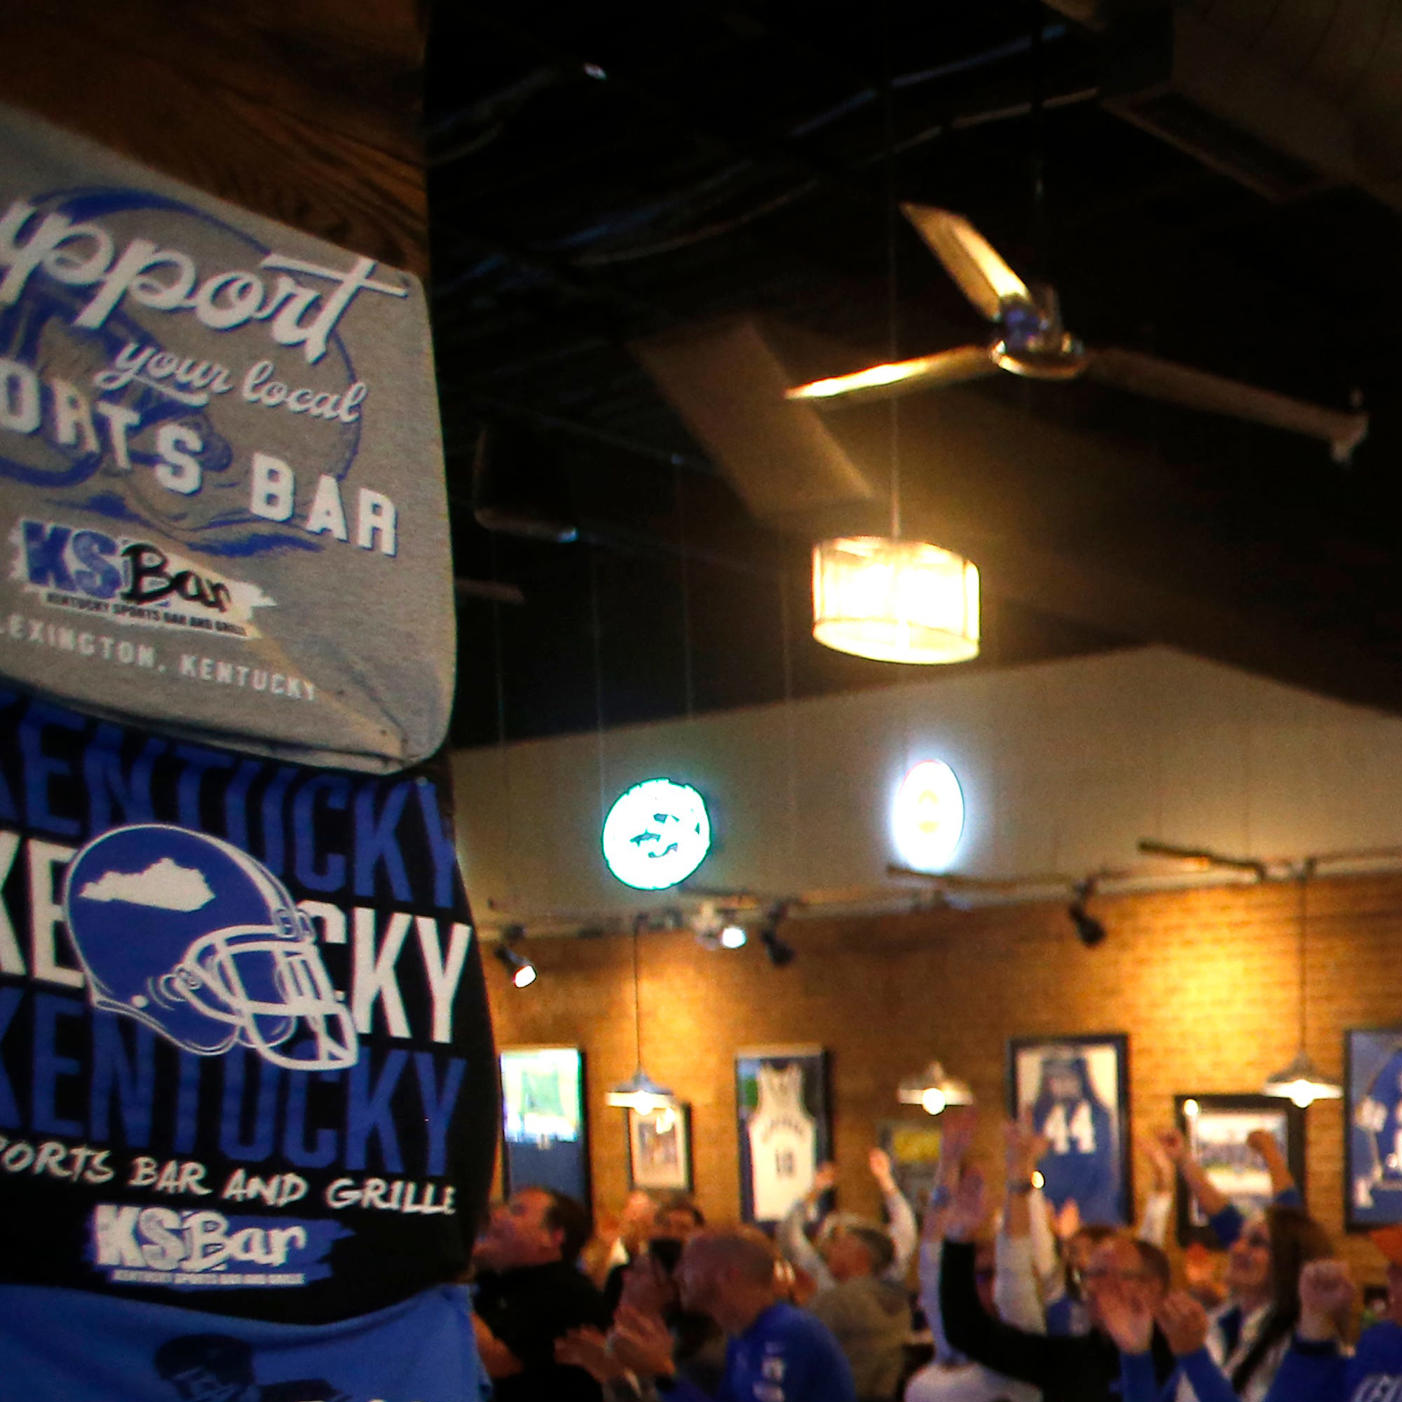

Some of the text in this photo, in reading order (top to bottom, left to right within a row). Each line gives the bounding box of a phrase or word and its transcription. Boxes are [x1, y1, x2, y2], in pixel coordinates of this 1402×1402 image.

[94, 342, 368, 423] your local
[250, 452, 397, 556] BAR
[0, 614, 318, 702] EXINGTON, KENTUCKY
[0, 690, 457, 909] ENTUCKY
[1043, 1099, 1096, 1155] 44
[128, 1157, 211, 1196] BAR
[222, 1168, 308, 1207] AND
[95, 1204, 307, 1272] KSBar
